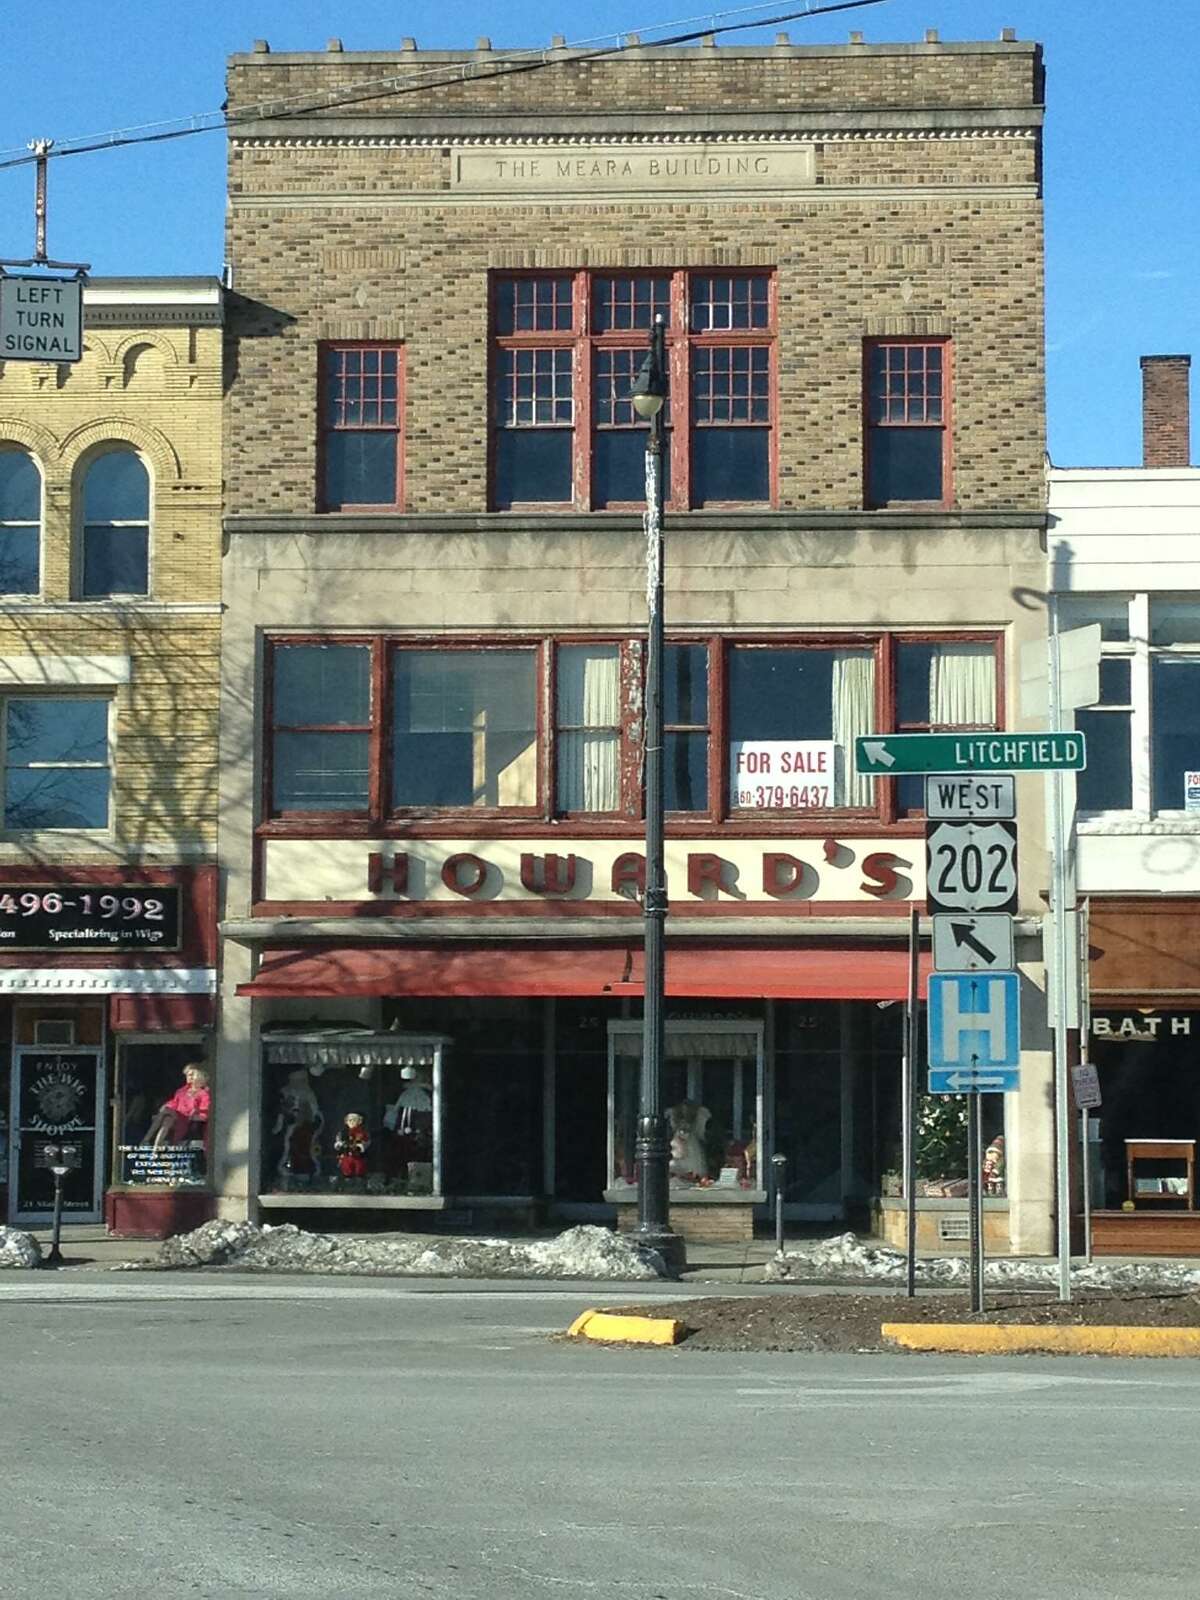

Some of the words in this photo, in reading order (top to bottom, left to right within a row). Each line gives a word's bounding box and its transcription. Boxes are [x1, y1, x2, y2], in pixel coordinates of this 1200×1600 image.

[496, 160, 540, 177] THE
[559, 160, 632, 176] MEARA
[650, 157, 769, 176] BUILDING
[17, 287, 63, 304] LEFT
[16, 311, 64, 328] TURN
[5, 334, 73, 353] SIGNAL
[736, 752, 771, 773] FOR
[781, 752, 827, 773] SALE
[955, 740, 1078, 764] LITCHFIELD
[938, 783, 1003, 810] WEST
[368, 838, 904, 896] HOWARD'S
[936, 844, 1009, 894] 202
[0, 892, 164, 921] 496-1992
[49, 928, 119, 942] Specializing
[121, 929, 133, 938] in
[135, 930, 163, 942] Wigs
[941, 980, 1006, 1061] H
[1092, 1017, 1191, 1036] BATH
